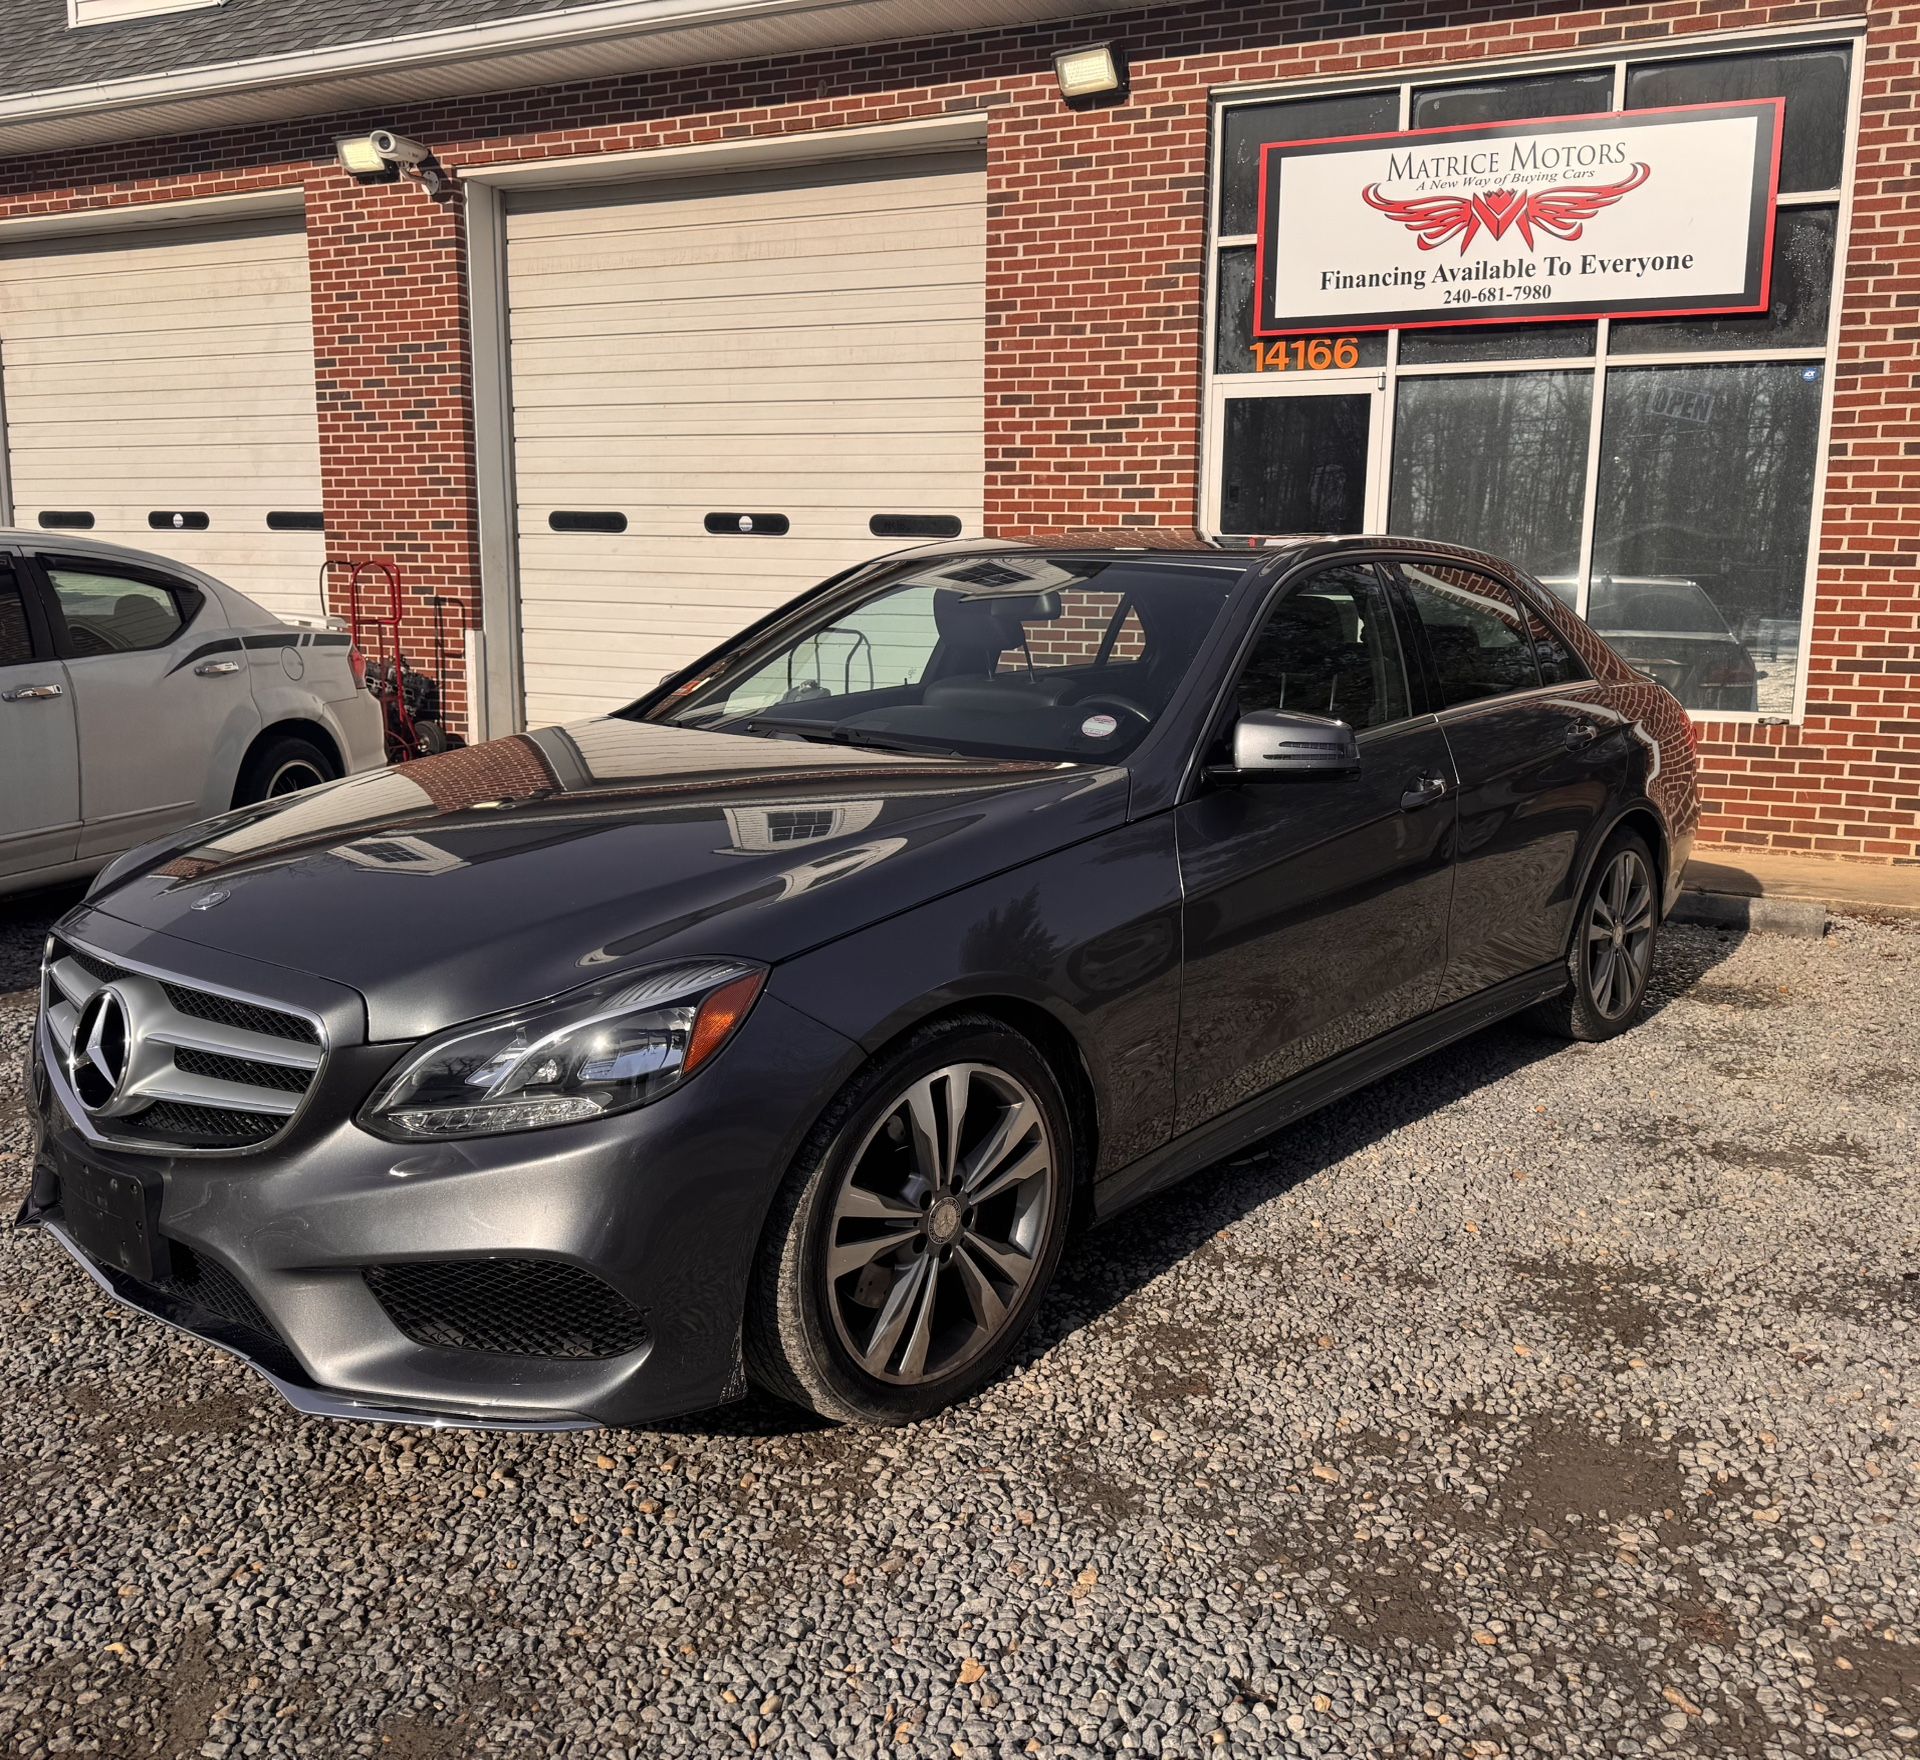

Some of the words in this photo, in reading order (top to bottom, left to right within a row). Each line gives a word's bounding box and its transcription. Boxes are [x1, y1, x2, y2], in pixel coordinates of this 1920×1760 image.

[1386, 151, 1500, 182] MATRICE
[1509, 140, 1626, 171] MOTORS
[1416, 181, 1426, 191] A
[1429, 179, 1459, 190] New
[1463, 176, 1491, 188] Way
[1494, 173, 1511, 186] of
[1511, 171, 1558, 185] Buying
[1562, 168, 1596, 180] Cars
[1319, 265, 1427, 290] Financing
[1431, 258, 1537, 283] Available
[1543, 255, 1572, 278] To
[1579, 252, 1695, 277] Everyone
[1443, 284, 1552, 304] 240-681-7980
[1249, 337, 1359, 372] 14166
[1652, 387, 1713, 421] OPEN
